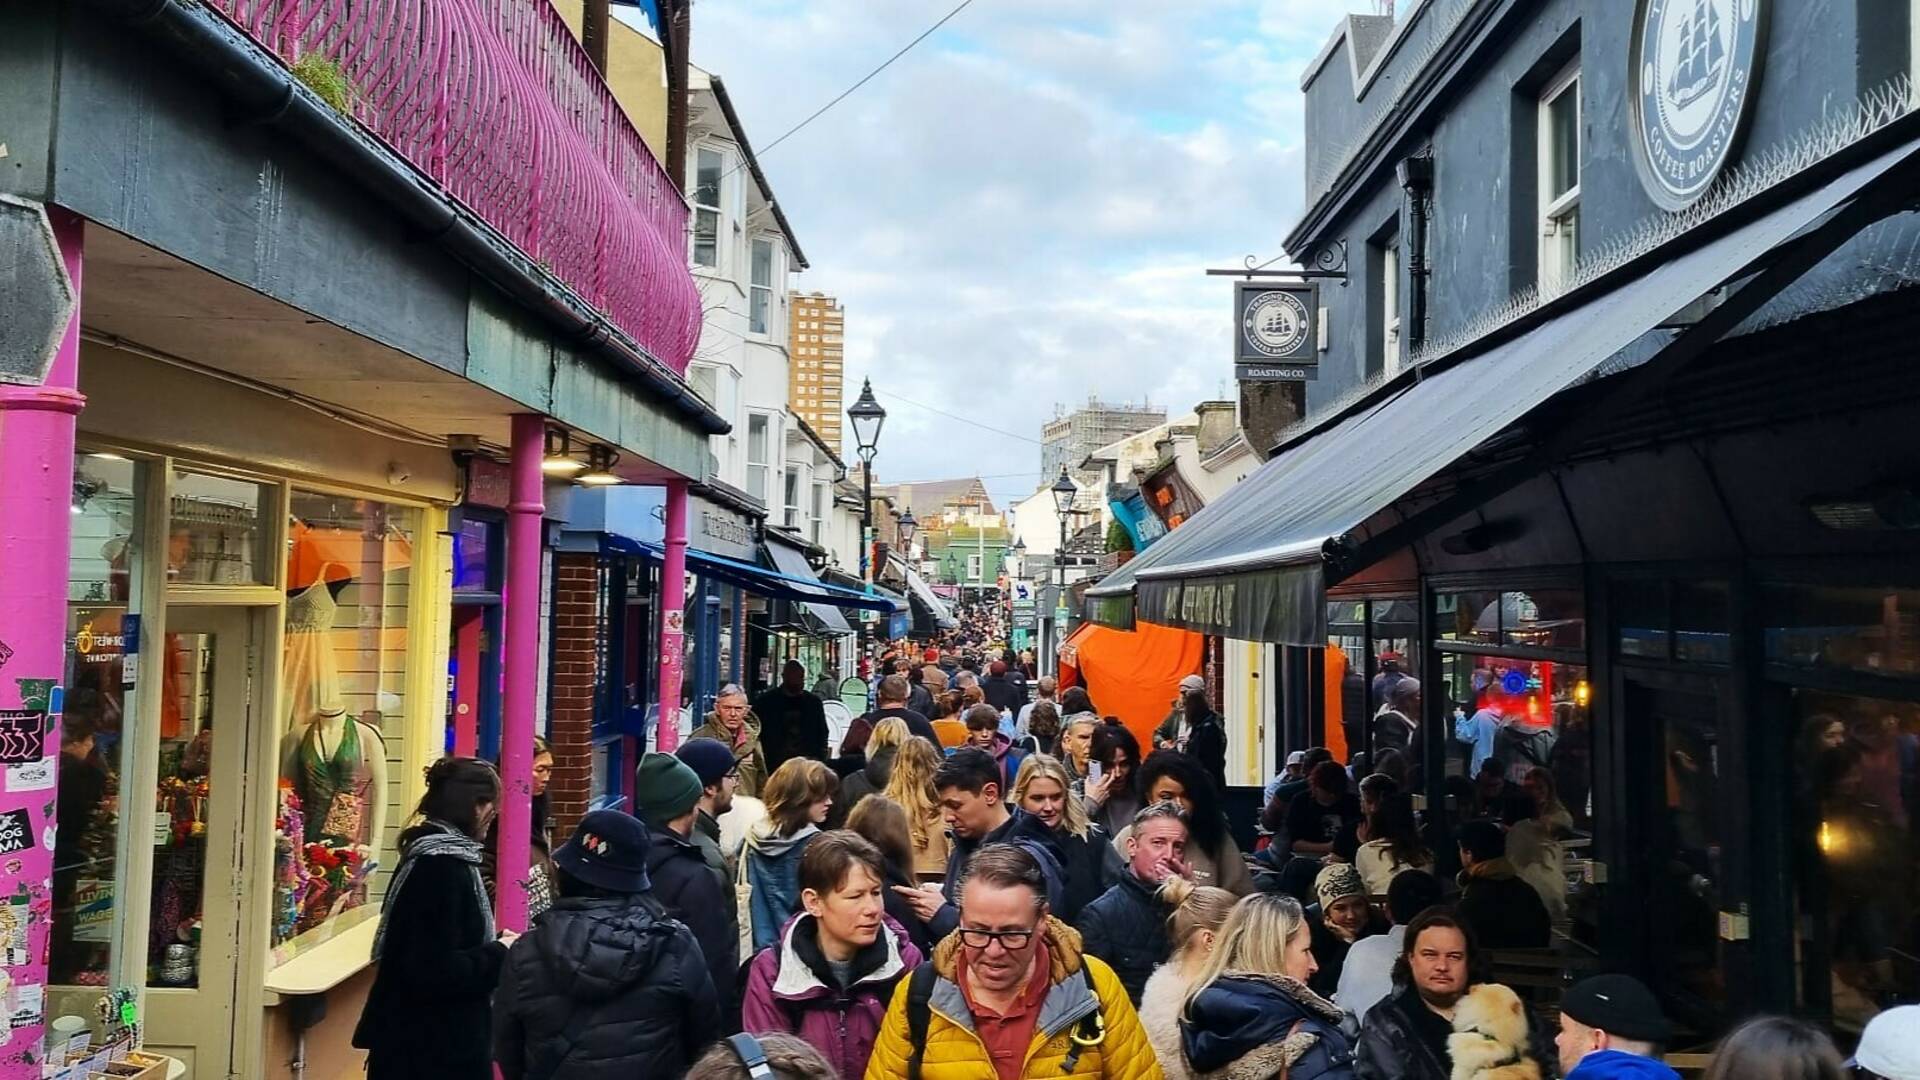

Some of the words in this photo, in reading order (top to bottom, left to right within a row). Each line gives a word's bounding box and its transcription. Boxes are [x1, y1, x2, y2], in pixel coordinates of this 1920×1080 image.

[1650, 126, 1685, 180] COFFEE
[1689, 68, 1744, 179] ROASTERS
[1250, 293, 1282, 311] TRADING
[1284, 295, 1302, 312] POST
[1247, 369, 1291, 377] ROASTING
[1291, 369, 1306, 378] CO.
[80, 888, 114, 903] LIVIN
